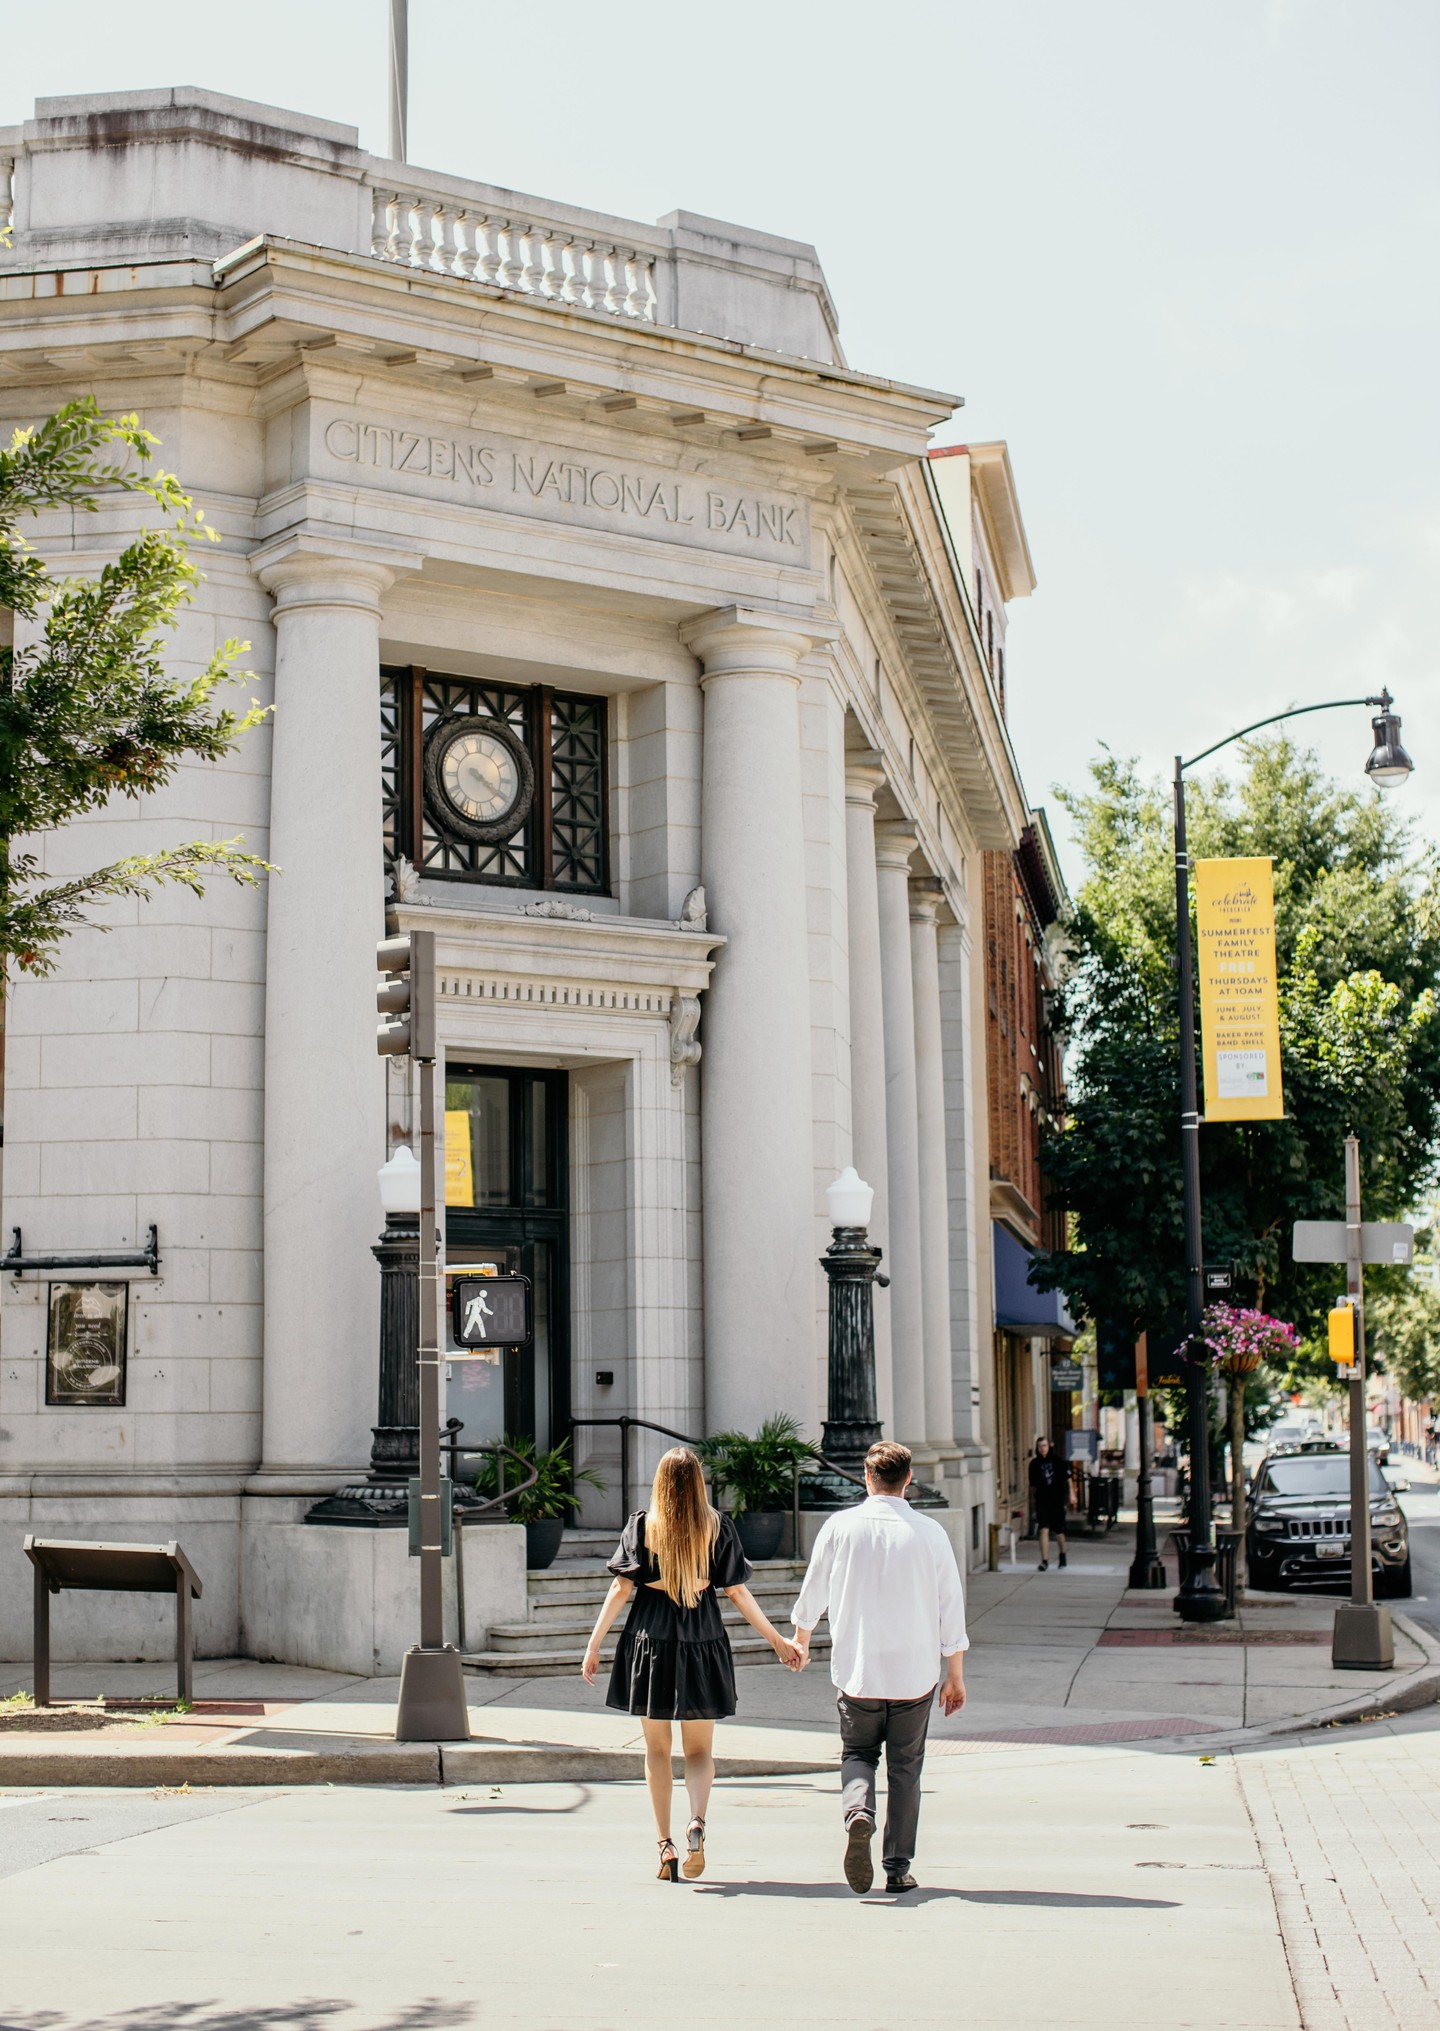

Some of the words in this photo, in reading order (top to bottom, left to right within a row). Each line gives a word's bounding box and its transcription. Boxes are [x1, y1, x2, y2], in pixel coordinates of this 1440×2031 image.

[325, 418, 496, 488] CITIZENS
[512, 452, 695, 526] NATIONAL
[707, 491, 801, 546] BANK
[1201, 927, 1270, 938] SUMMERFEST
[1217, 939, 1255, 948] FAMILY
[1213, 949, 1260, 958] THEATRE
[1219, 961, 1255, 974] FREE
[1209, 976, 1268, 986] THURSDAYS
[1218, 988, 1231, 996] AT
[1234, 987, 1263, 996] 10AM
[1218, 1052, 1265, 1061] SPONSORED
[1235, 1062, 1246, 1070] BY
